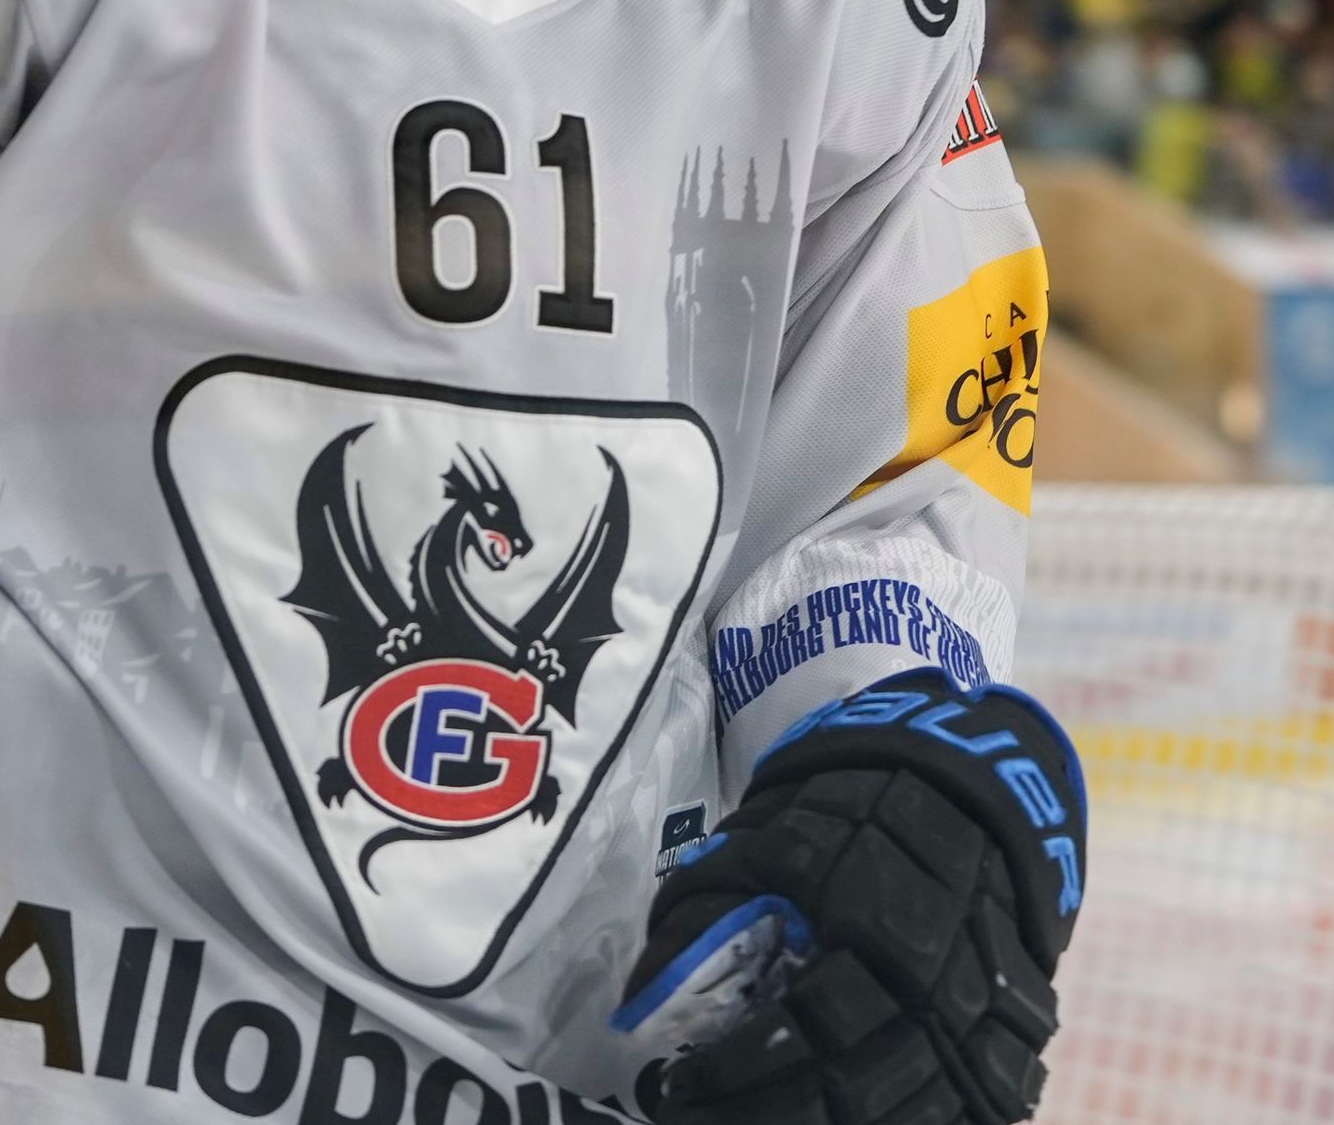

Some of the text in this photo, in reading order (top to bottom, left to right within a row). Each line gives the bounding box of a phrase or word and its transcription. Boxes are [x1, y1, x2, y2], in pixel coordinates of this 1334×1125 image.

[390, 98, 615, 335] 61
[945, 329, 1039, 426] CHI
[807, 578, 923, 625] HOCKEYS
[832, 611, 901, 649] LAND
